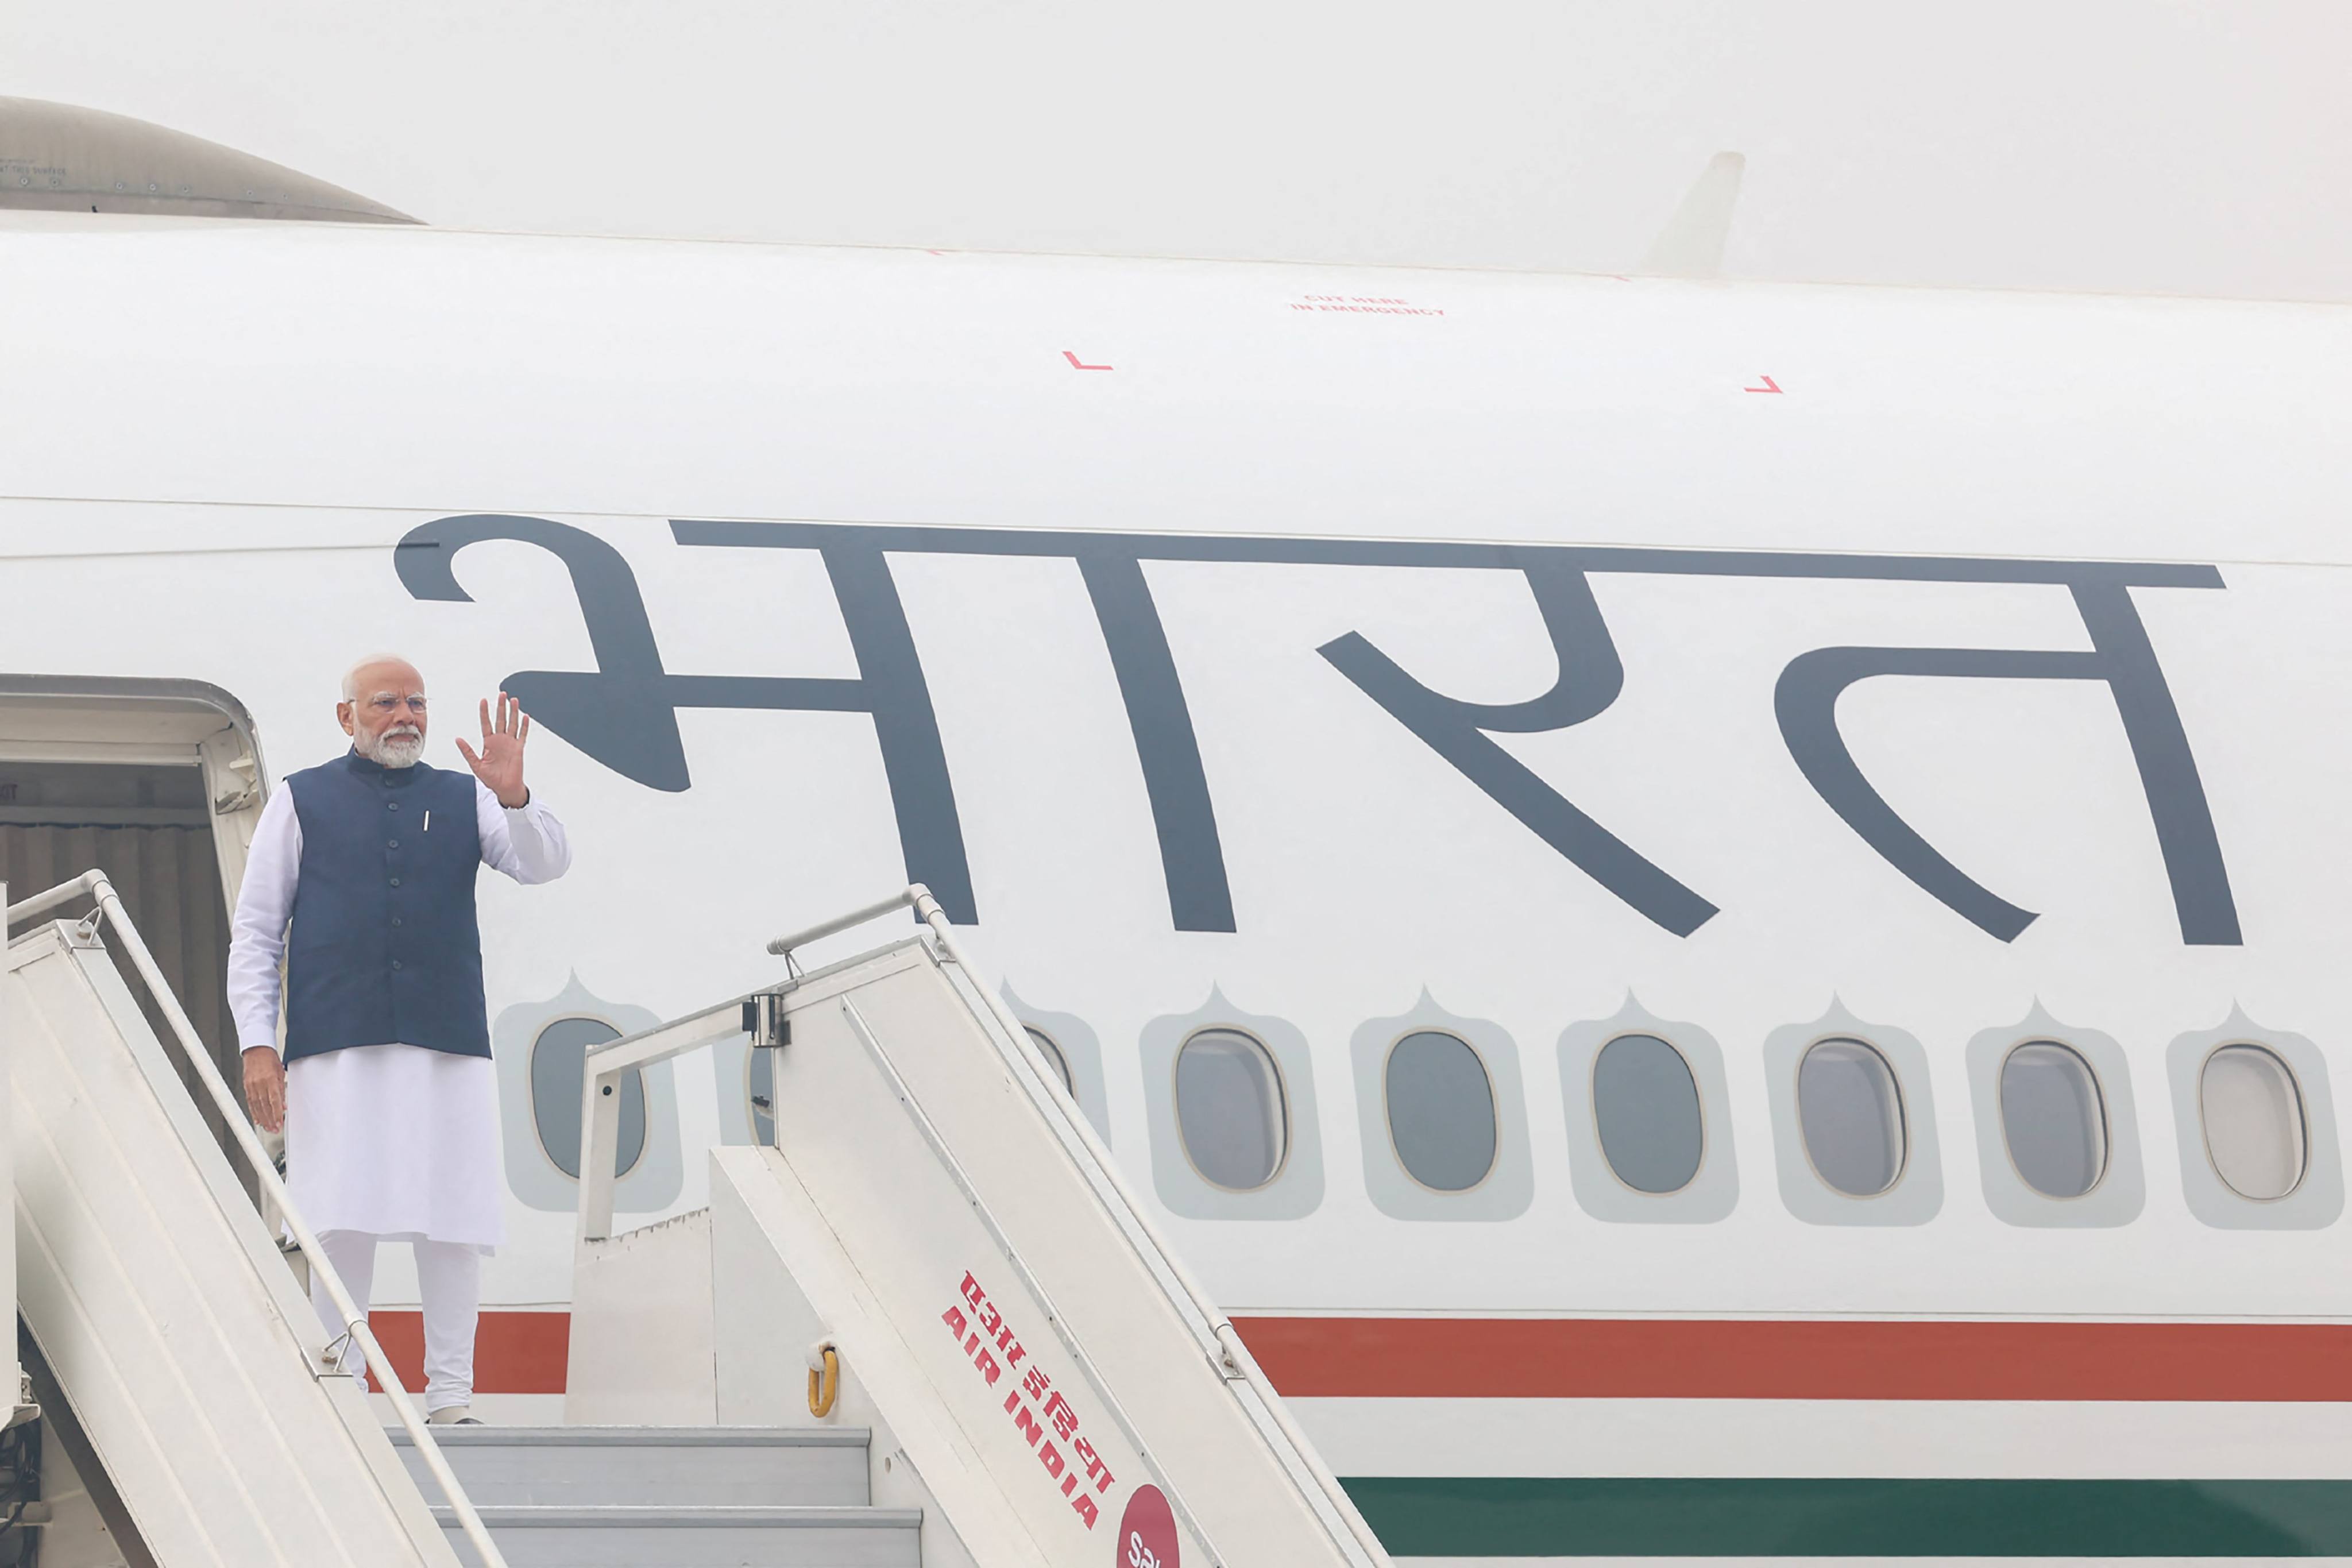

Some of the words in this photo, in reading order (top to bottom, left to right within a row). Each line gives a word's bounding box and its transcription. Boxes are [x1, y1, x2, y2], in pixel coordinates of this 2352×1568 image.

[1318, 304, 1445, 316] EMERGENCY
[1350, 296, 1409, 305] HERE
[395, 515, 2243, 946] भारत
[941, 1306, 1001, 1389] AIR
[1003, 1389, 1099, 1530] INDIA
